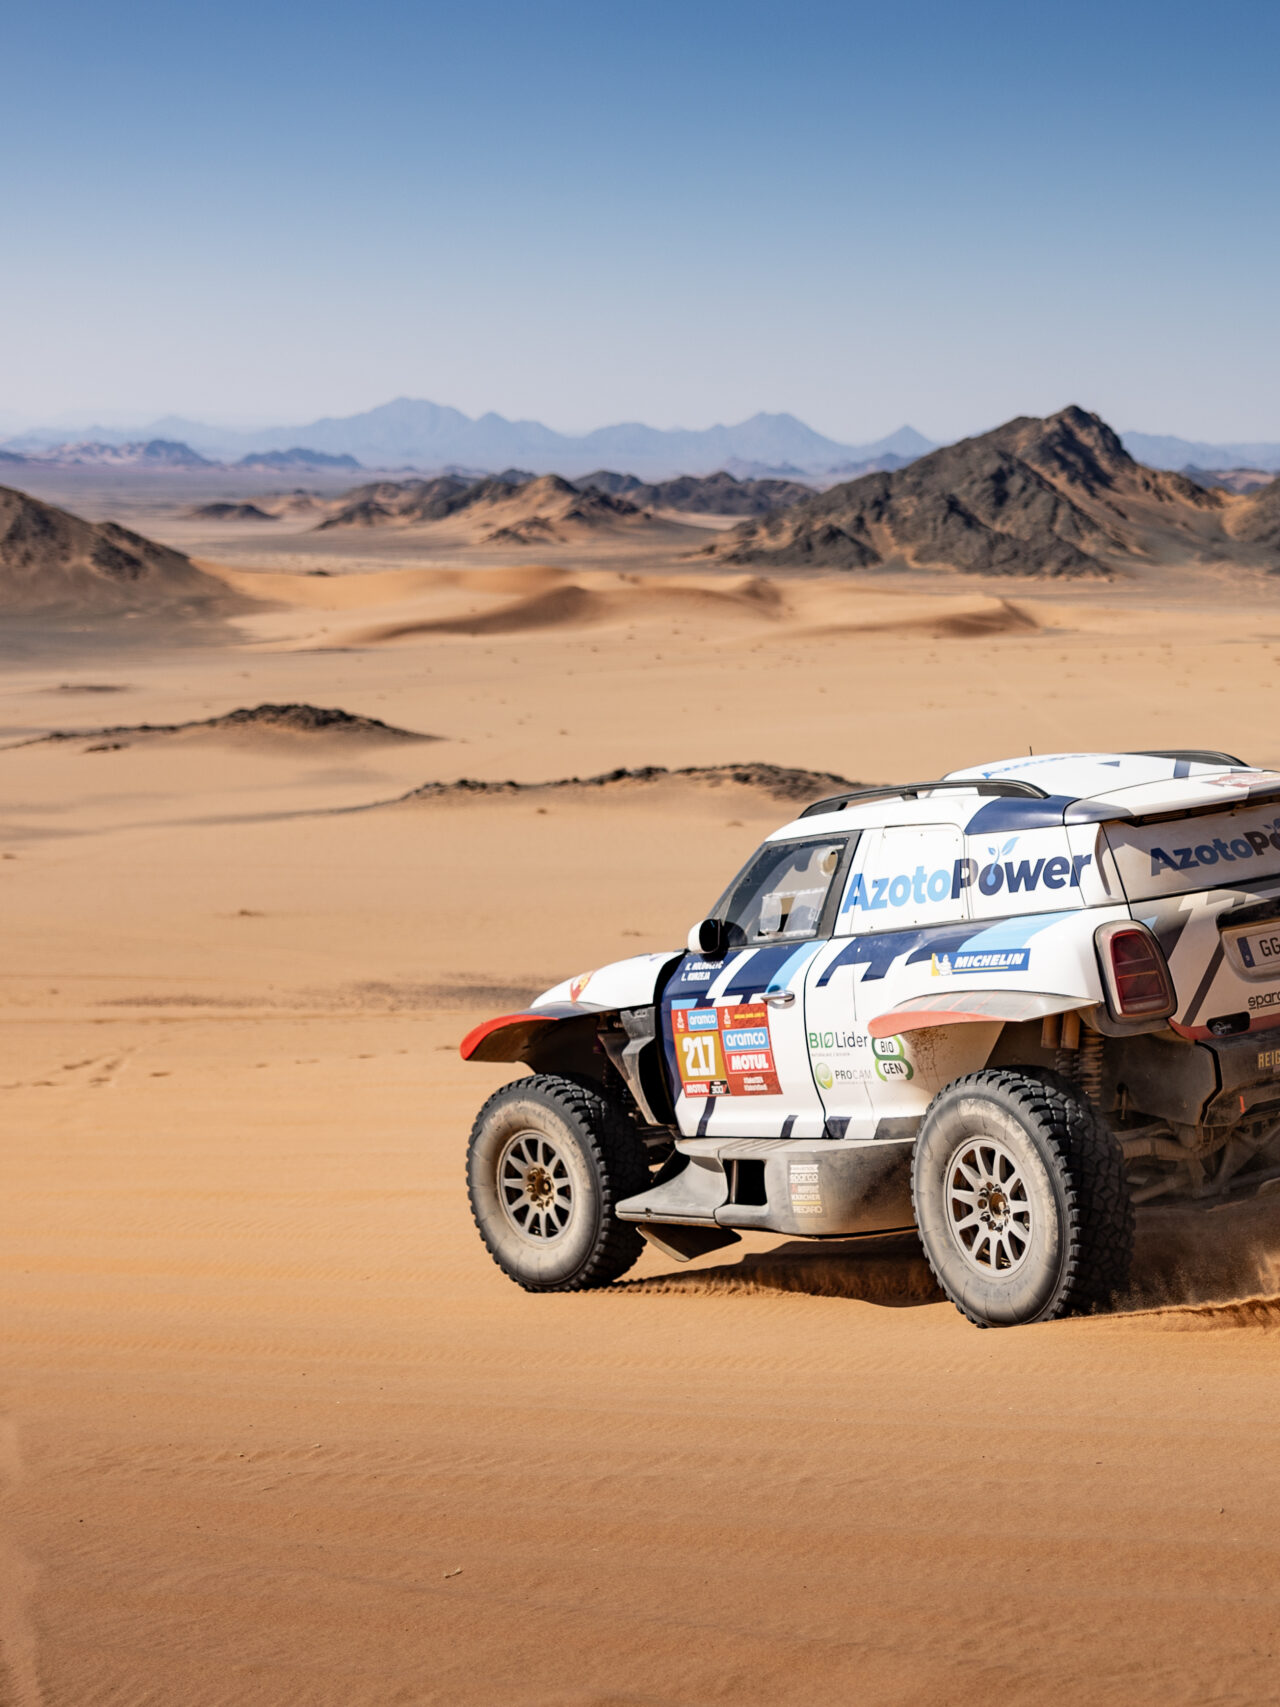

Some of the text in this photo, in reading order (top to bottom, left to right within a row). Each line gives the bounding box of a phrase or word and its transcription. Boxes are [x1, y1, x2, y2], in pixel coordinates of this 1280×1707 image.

[841, 853, 1092, 914] AzotoPower
[954, 952, 1025, 969] MICHELIN
[689, 1014, 716, 1025] aramco
[726, 1031, 766, 1047] aramco
[880, 1041, 894, 1053] BIO
[682, 1035, 716, 1077] 217
[731, 1053, 769, 1071] MOTUL
[883, 1062, 904, 1075] GEN
[686, 1083, 709, 1094] MOTUL
